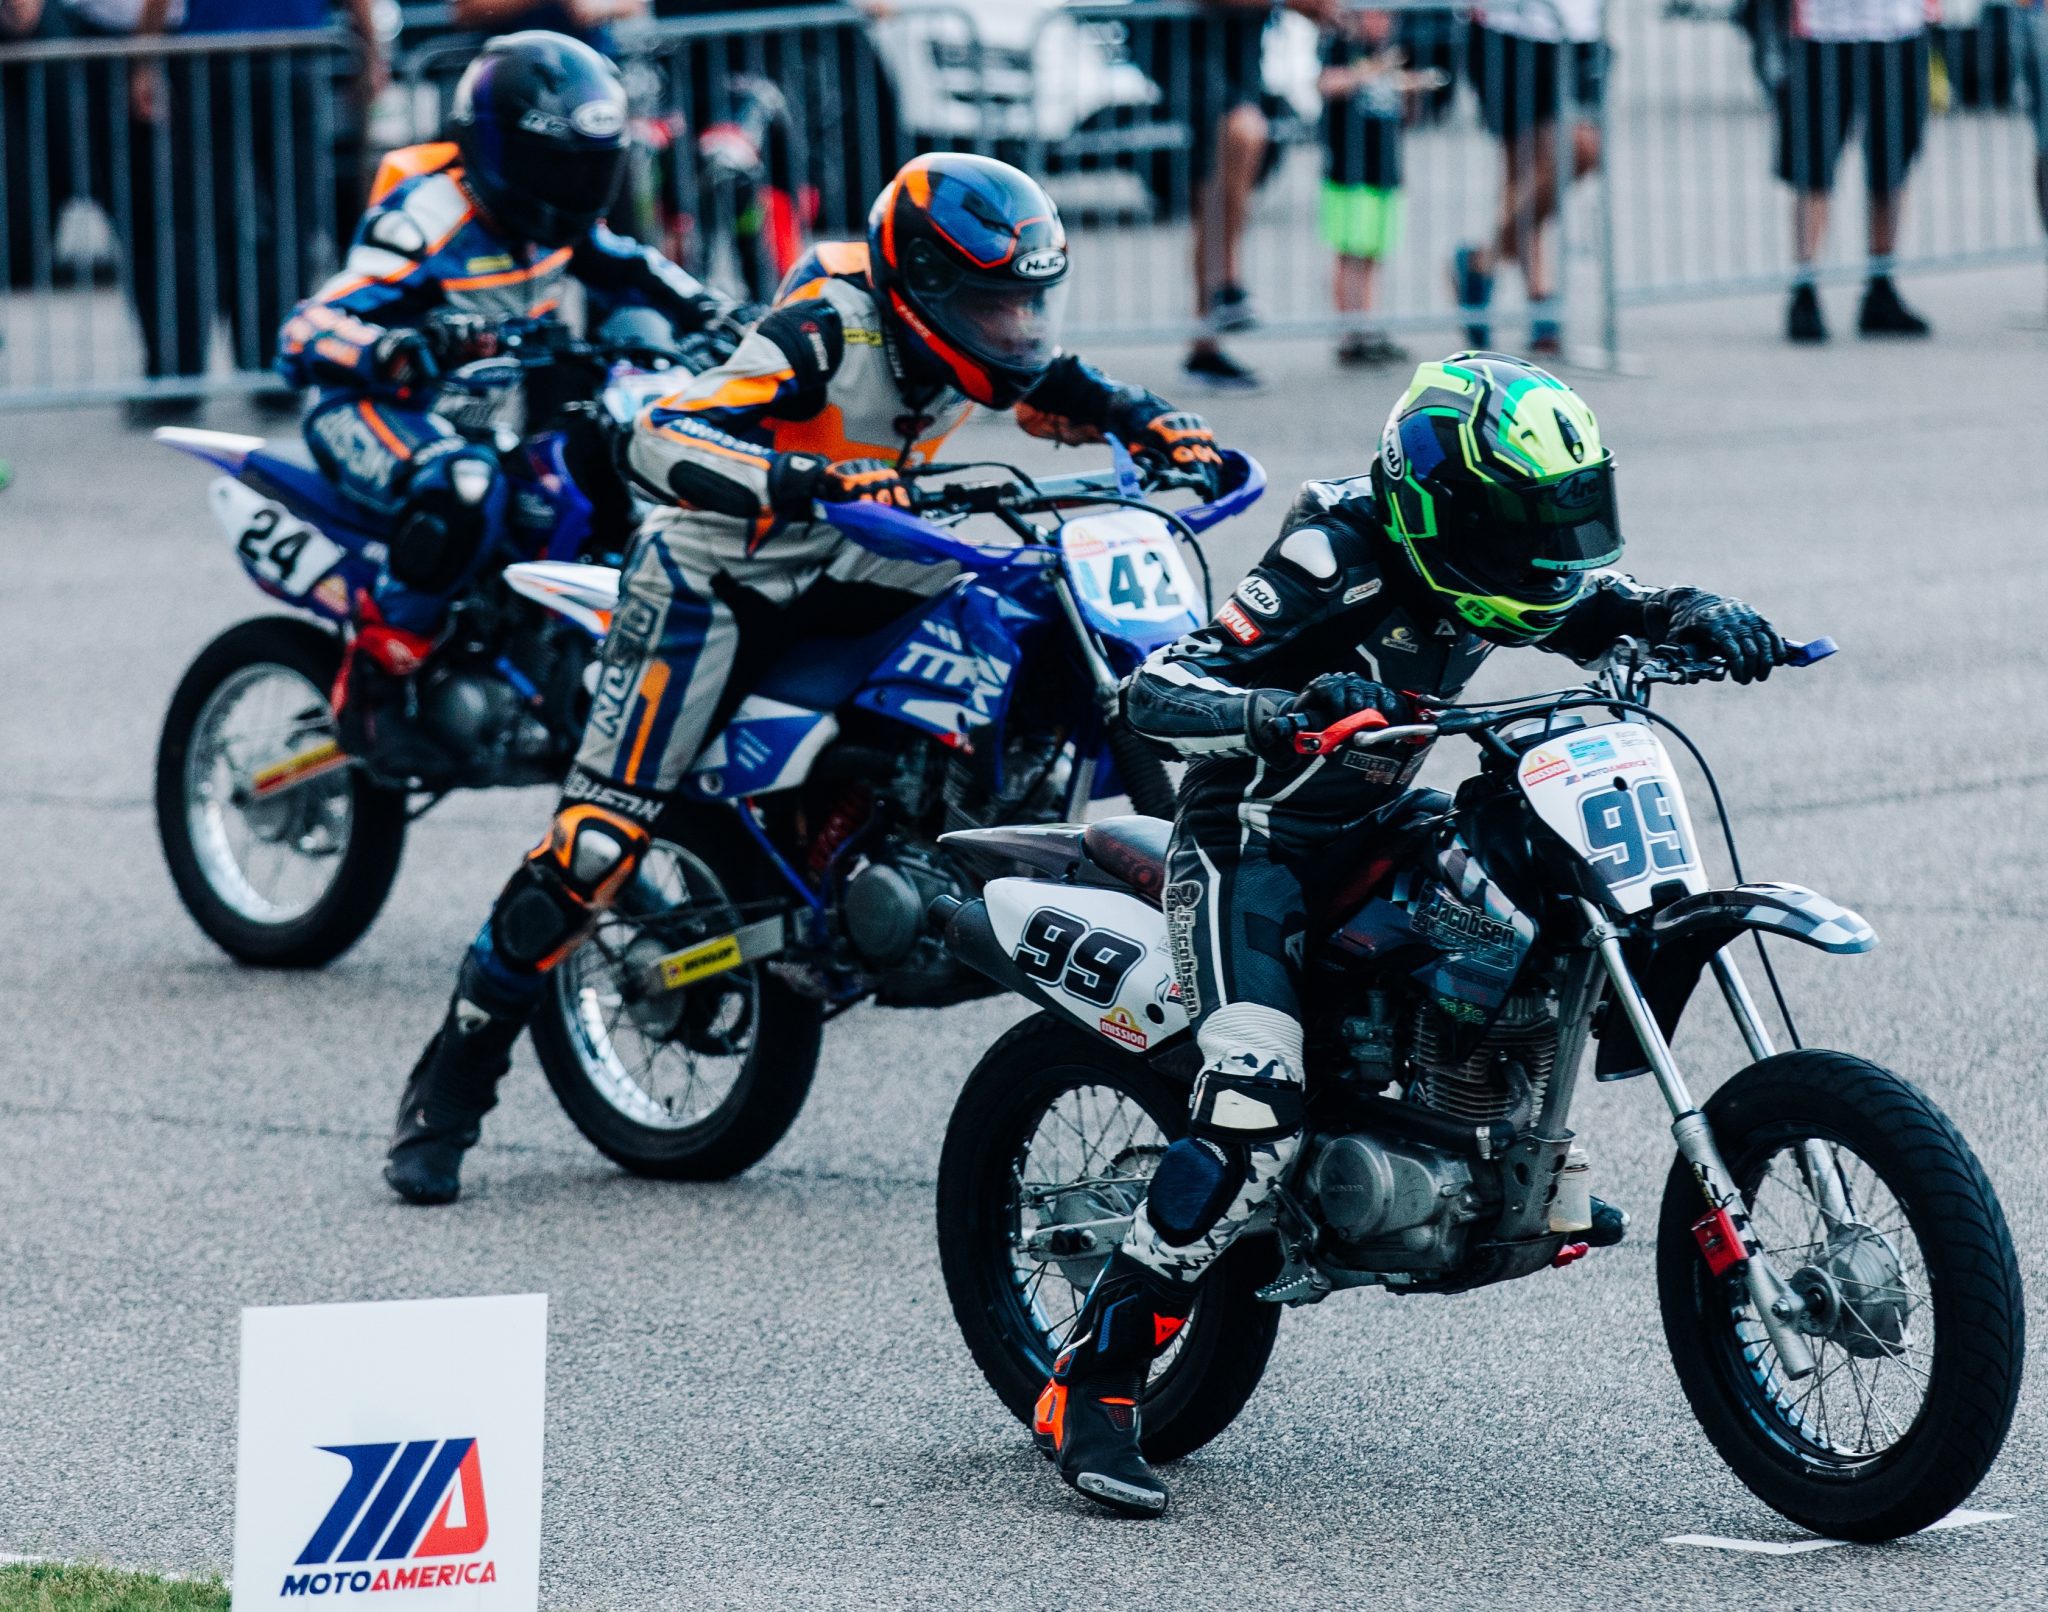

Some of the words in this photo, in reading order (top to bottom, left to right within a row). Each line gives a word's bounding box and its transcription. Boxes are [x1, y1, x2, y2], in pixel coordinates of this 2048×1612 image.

[238, 509, 311, 581] 24
[1109, 552, 1182, 610] 42
[1240, 579, 1280, 610] Arai
[1220, 606, 1257, 642] OTUL
[1582, 759, 1647, 780] MOTOAMERICA
[1577, 776, 1696, 892] 99
[1012, 906, 1147, 1009] 99
[1178, 910, 1199, 1015] Jacobsen
[280, 1560, 497, 1597] MOTOAMERICA
